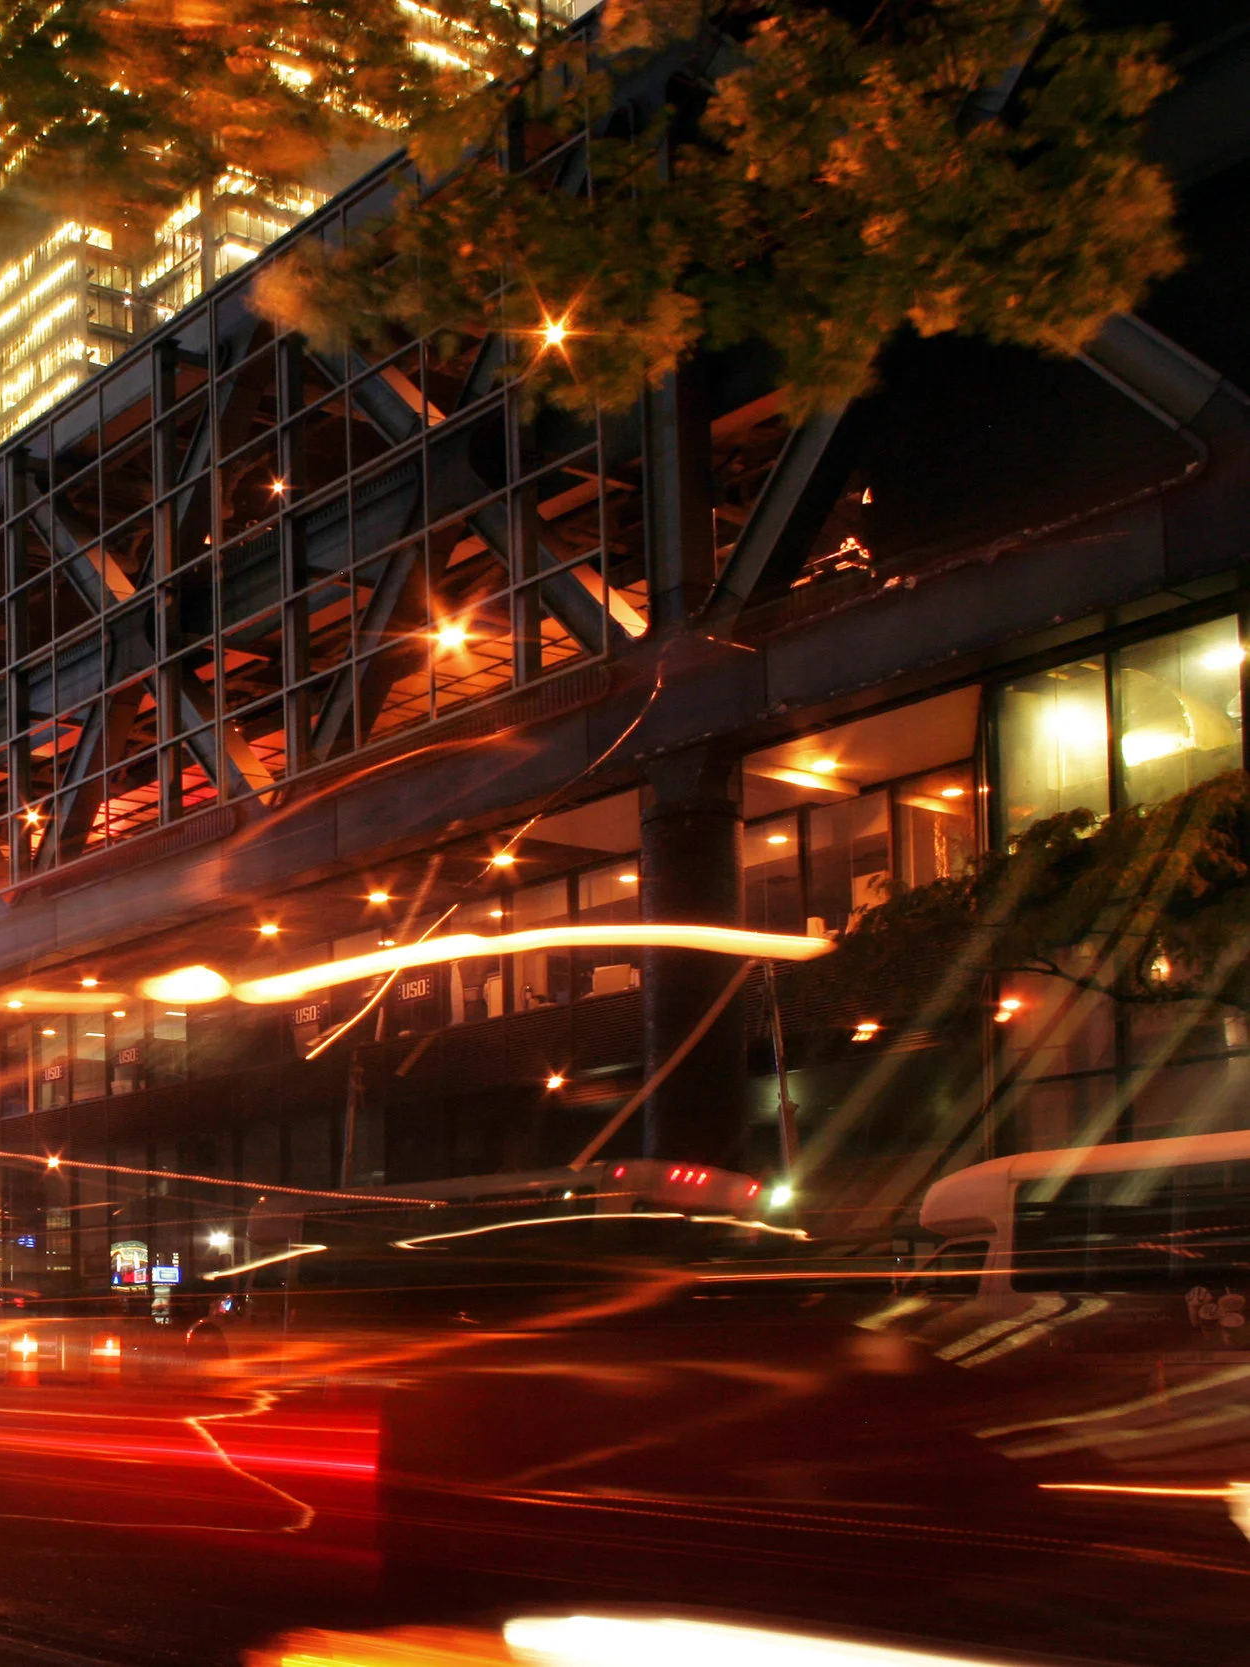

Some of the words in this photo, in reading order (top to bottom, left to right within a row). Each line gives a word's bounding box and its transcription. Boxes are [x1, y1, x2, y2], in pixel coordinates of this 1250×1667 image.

[401, 979, 427, 1000] USO
[295, 1005, 318, 1024] USO
[118, 1048, 136, 1065] USO
[44, 1065, 61, 1081] USO
